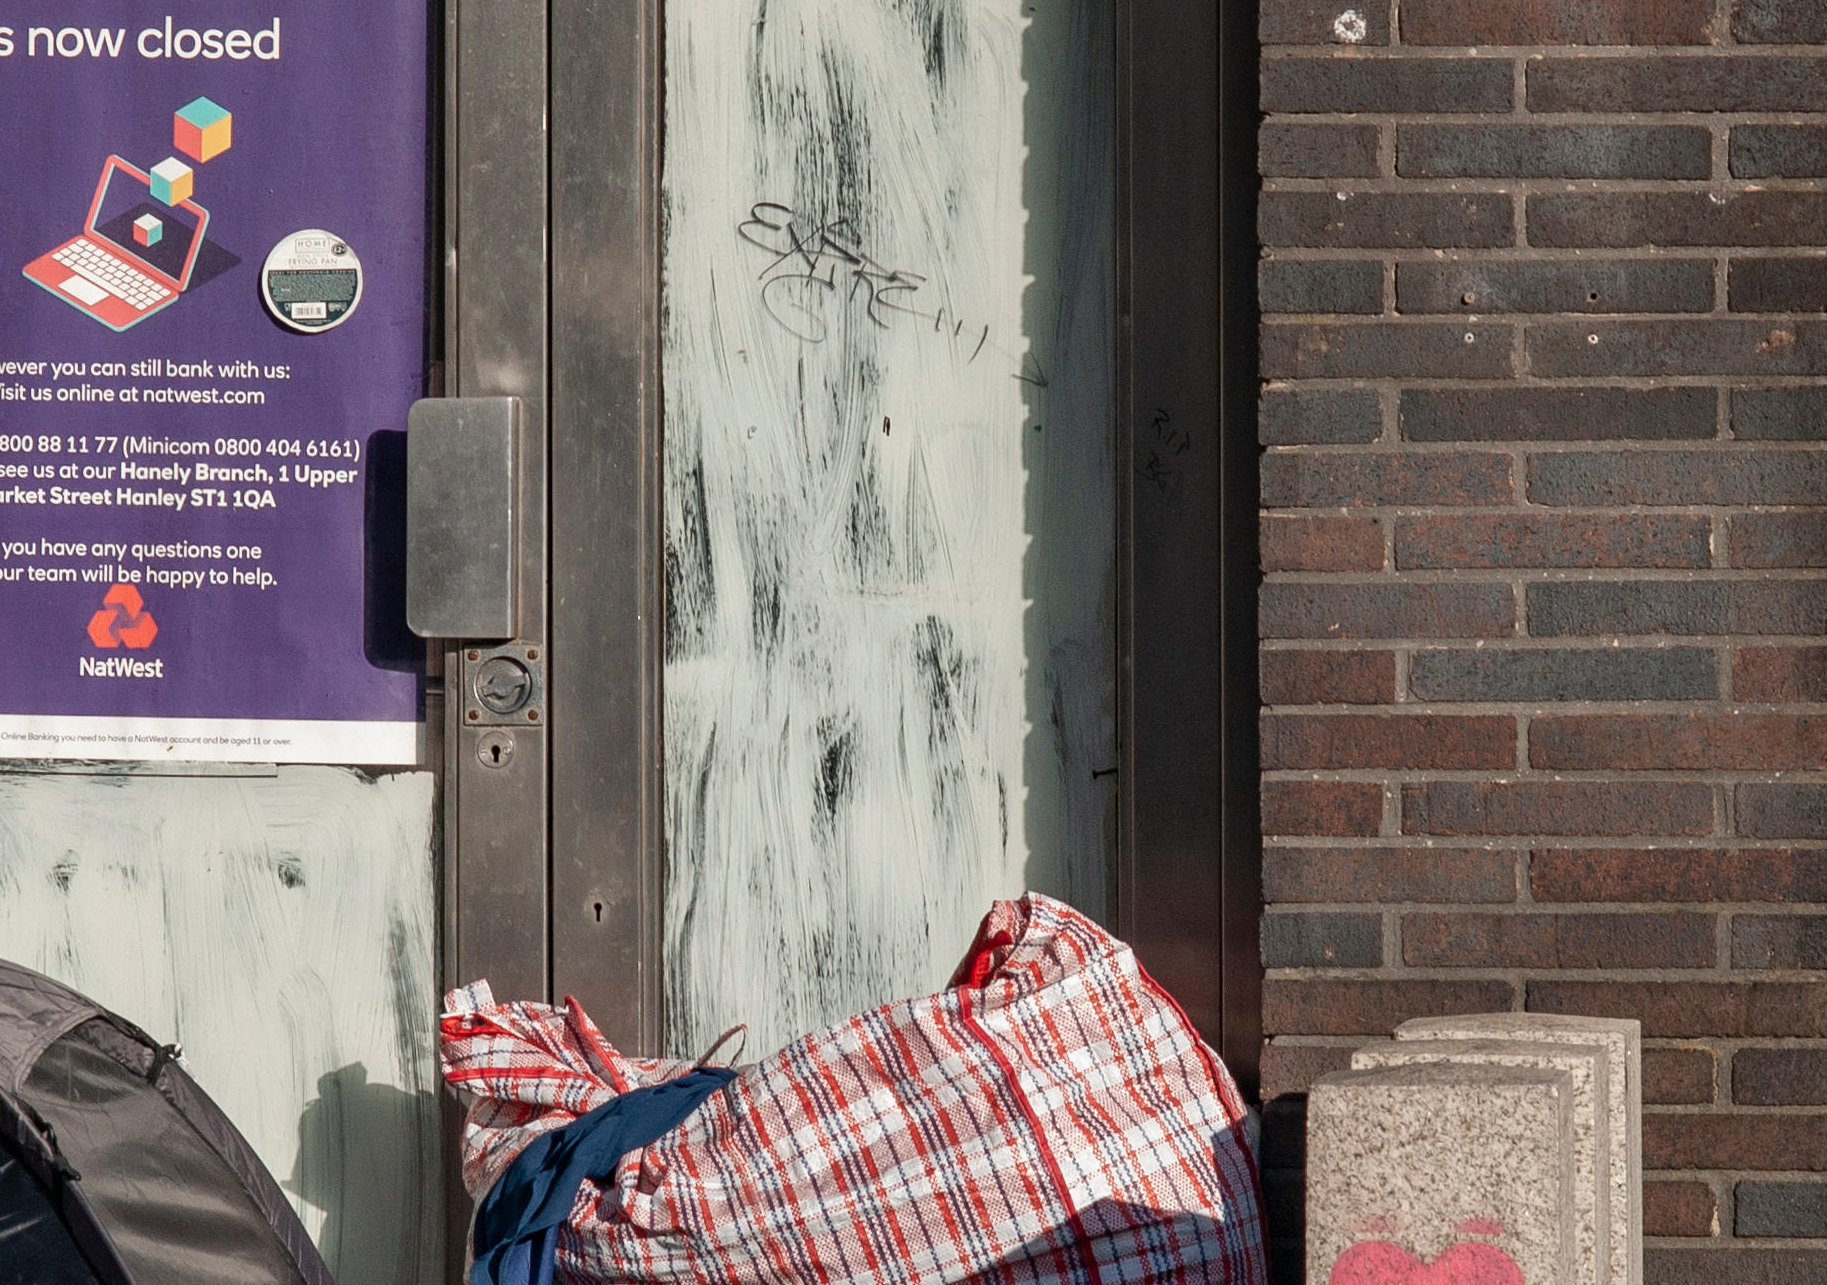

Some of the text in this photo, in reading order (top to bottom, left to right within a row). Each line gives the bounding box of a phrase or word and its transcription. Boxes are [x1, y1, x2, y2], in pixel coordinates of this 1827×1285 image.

[28, 26, 126, 58] now
[137, 15, 280, 60] closed
[320, 258, 338, 266] PAN
[50, 362, 86, 381] you
[90, 362, 126, 377] can
[130, 358, 162, 377] still
[166, 359, 214, 378] bank
[217, 359, 259, 379] with
[263, 365, 291, 379] us:
[30, 387, 53, 401] us
[56, 383, 115, 402] online
[118, 386, 139, 403] at
[143, 387, 265, 404] natwest.com
[37, 435, 62, 453] 88
[67, 435, 89, 454] 11
[94, 436, 118, 454] 77
[122, 435, 210, 459] (Minicom
[214, 437, 262, 456] 0800
[265, 438, 302, 457] 404
[306, 439, 360, 462] 6161)
[33, 465, 55, 479] us
[59, 463, 79, 479] at
[82, 465, 117, 480] our
[120, 461, 192, 486] Hanely
[195, 462, 274, 485] Branch,
[278, 465, 290, 483] 1
[294, 464, 359, 488] Upper
[49, 486, 112, 506] Street
[116, 487, 187, 511] Hanley
[190, 488, 228, 507] ST1
[232, 489, 277, 510] 1QA
[1, 542, 37, 560] you
[41, 537, 88, 557] have
[91, 543, 128, 562] any
[131, 539, 222, 563] questions
[226, 545, 262, 560] one
[27, 565, 77, 582] team
[81, 564, 113, 583] will
[117, 564, 142, 583] be
[146, 565, 206, 589] happy
[208, 568, 229, 585] to
[232, 566, 278, 590] help.
[79, 656, 164, 678] NatWest
[1, 732, 27, 741] Online
[28, 732, 60, 744] Banking
[61, 735, 77, 744] you
[77, 733, 98, 742] need
[98, 734, 107, 743] to
[108, 734, 128, 743] have
[135, 735, 169, 744] NatWest
[169, 736, 202, 744] account
[203, 736, 219, 745] and
[220, 736, 230, 745] be
[231, 737, 252, 747] aged
[253, 737, 262, 746] 11
[263, 738, 272, 746] or
